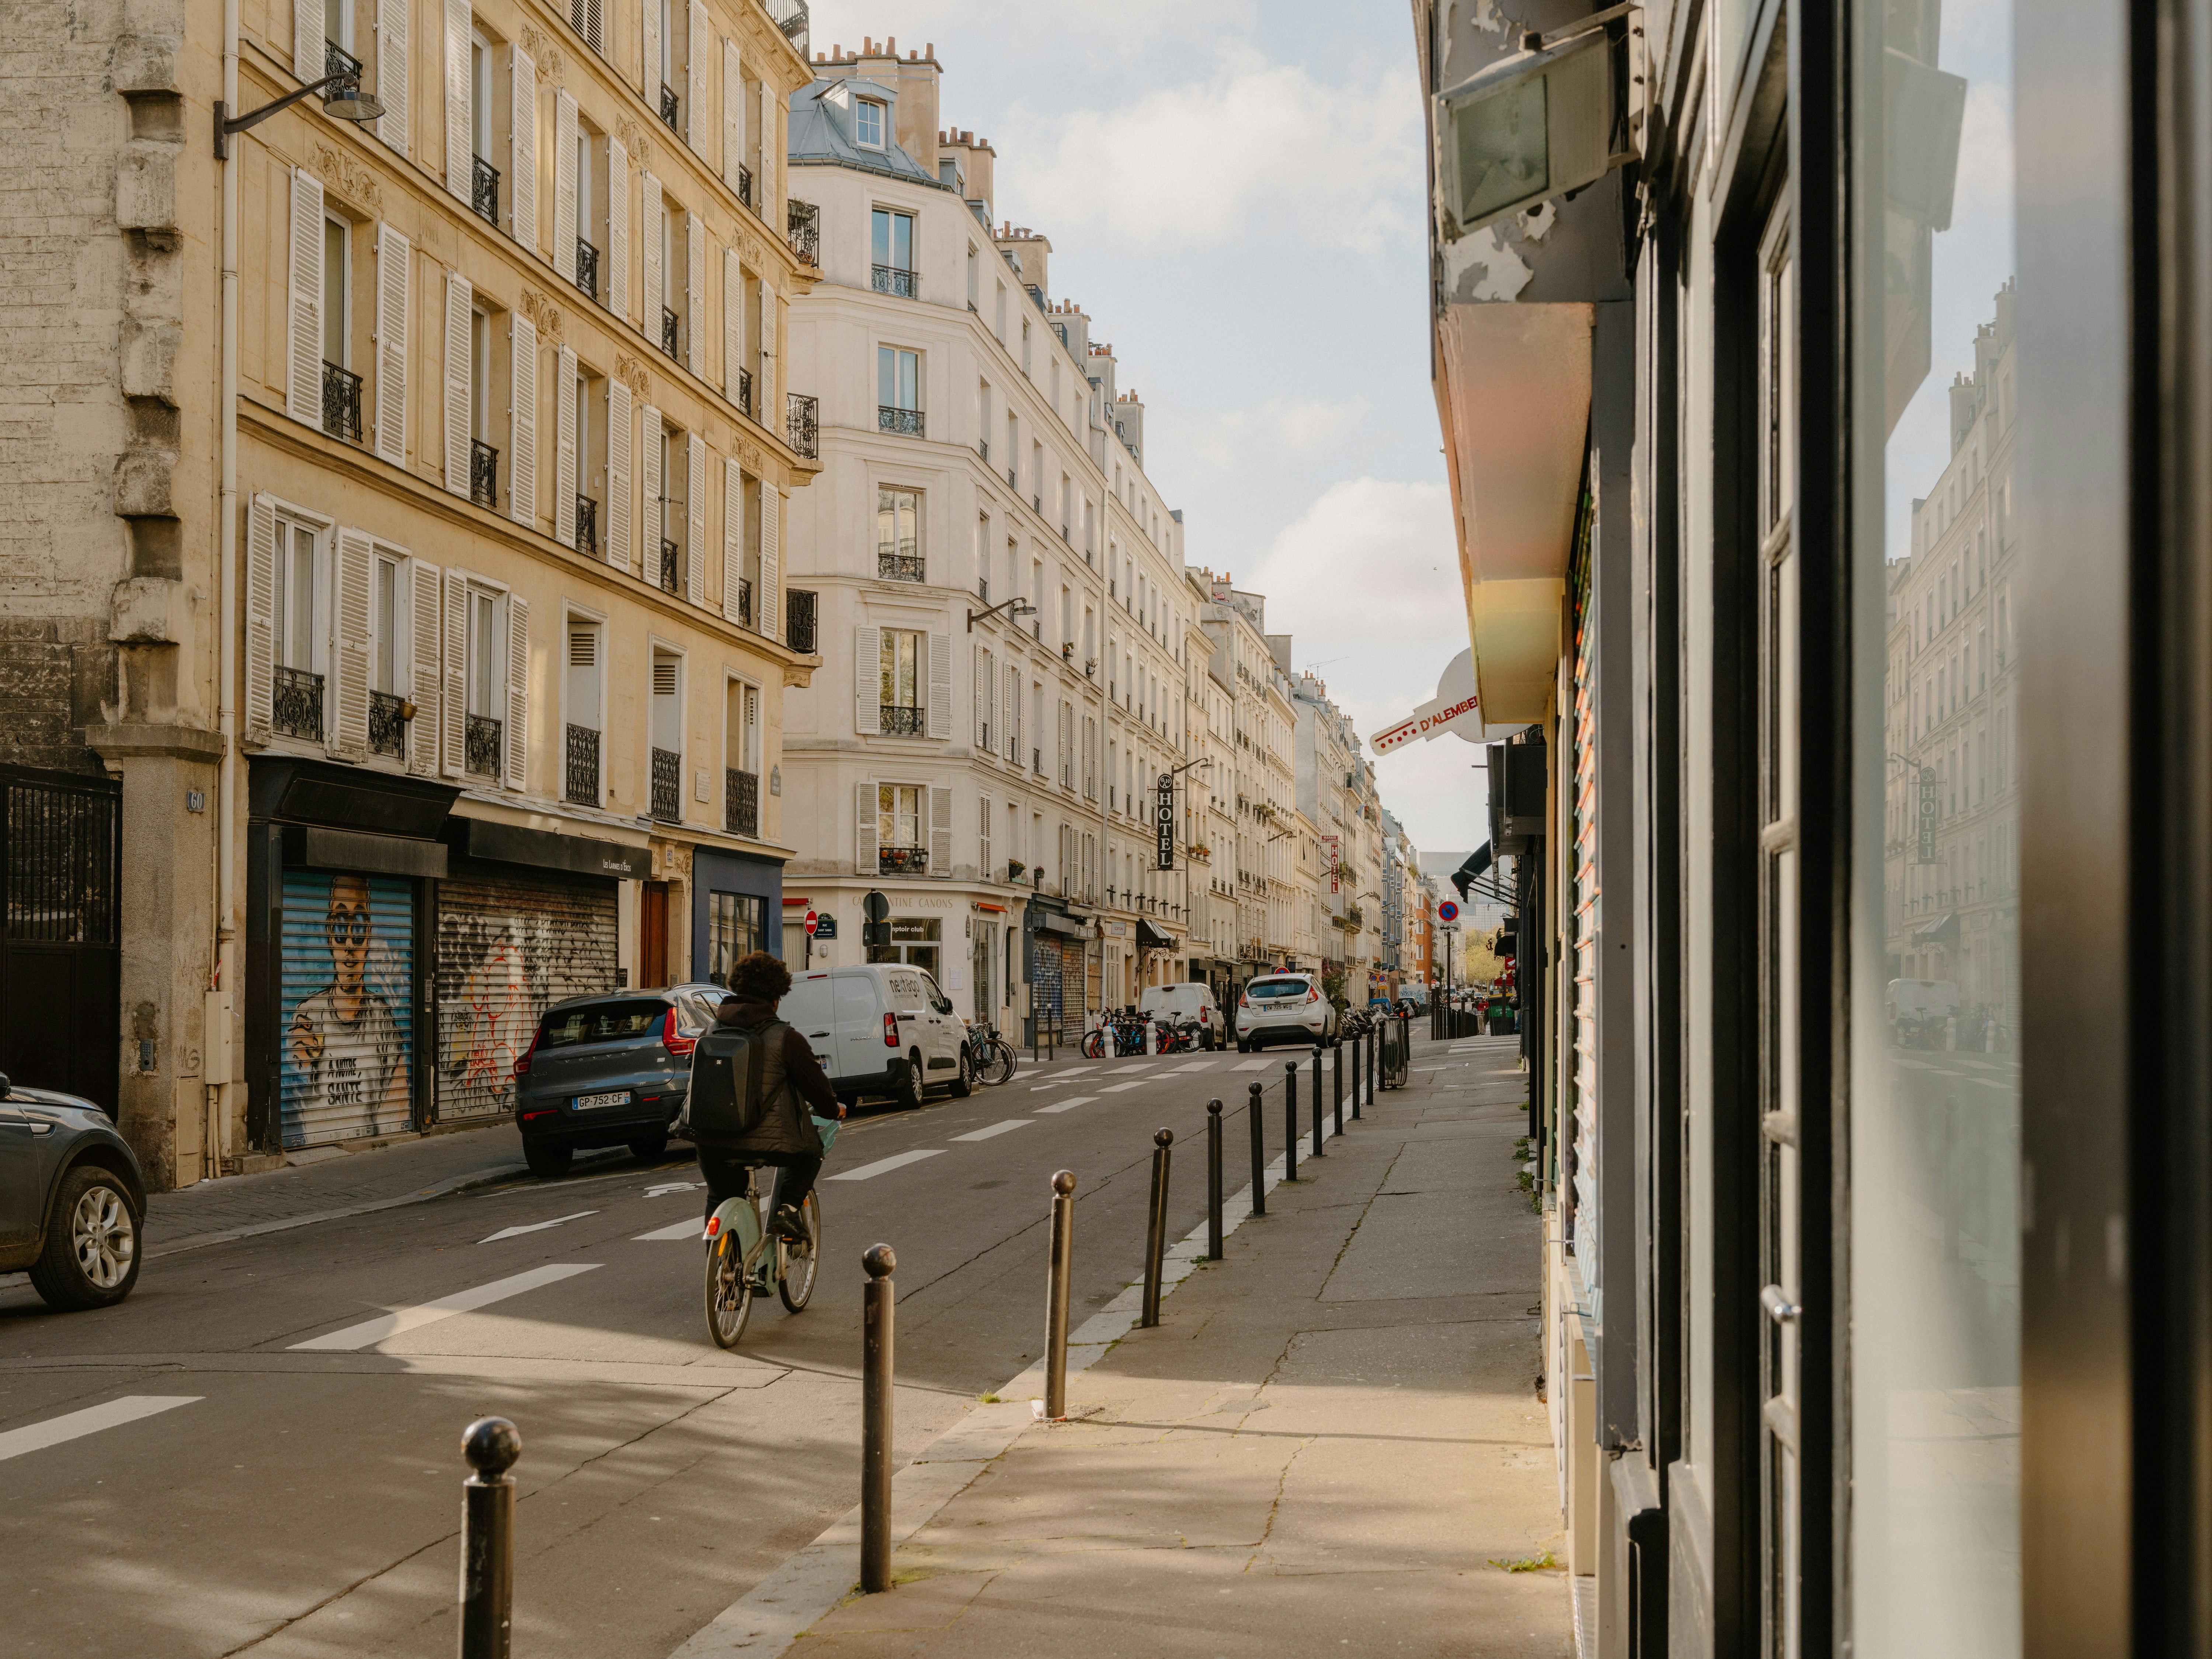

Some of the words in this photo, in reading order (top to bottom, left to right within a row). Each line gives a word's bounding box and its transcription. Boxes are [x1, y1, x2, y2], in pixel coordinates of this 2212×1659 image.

[191, 793, 202, 808] 60
[1159, 793, 1172, 865] HOTEL
[668, 851, 672, 859] 58
[919, 898, 953, 908] CANONS
[579, 1093, 623, 1107] GP-752-CF
